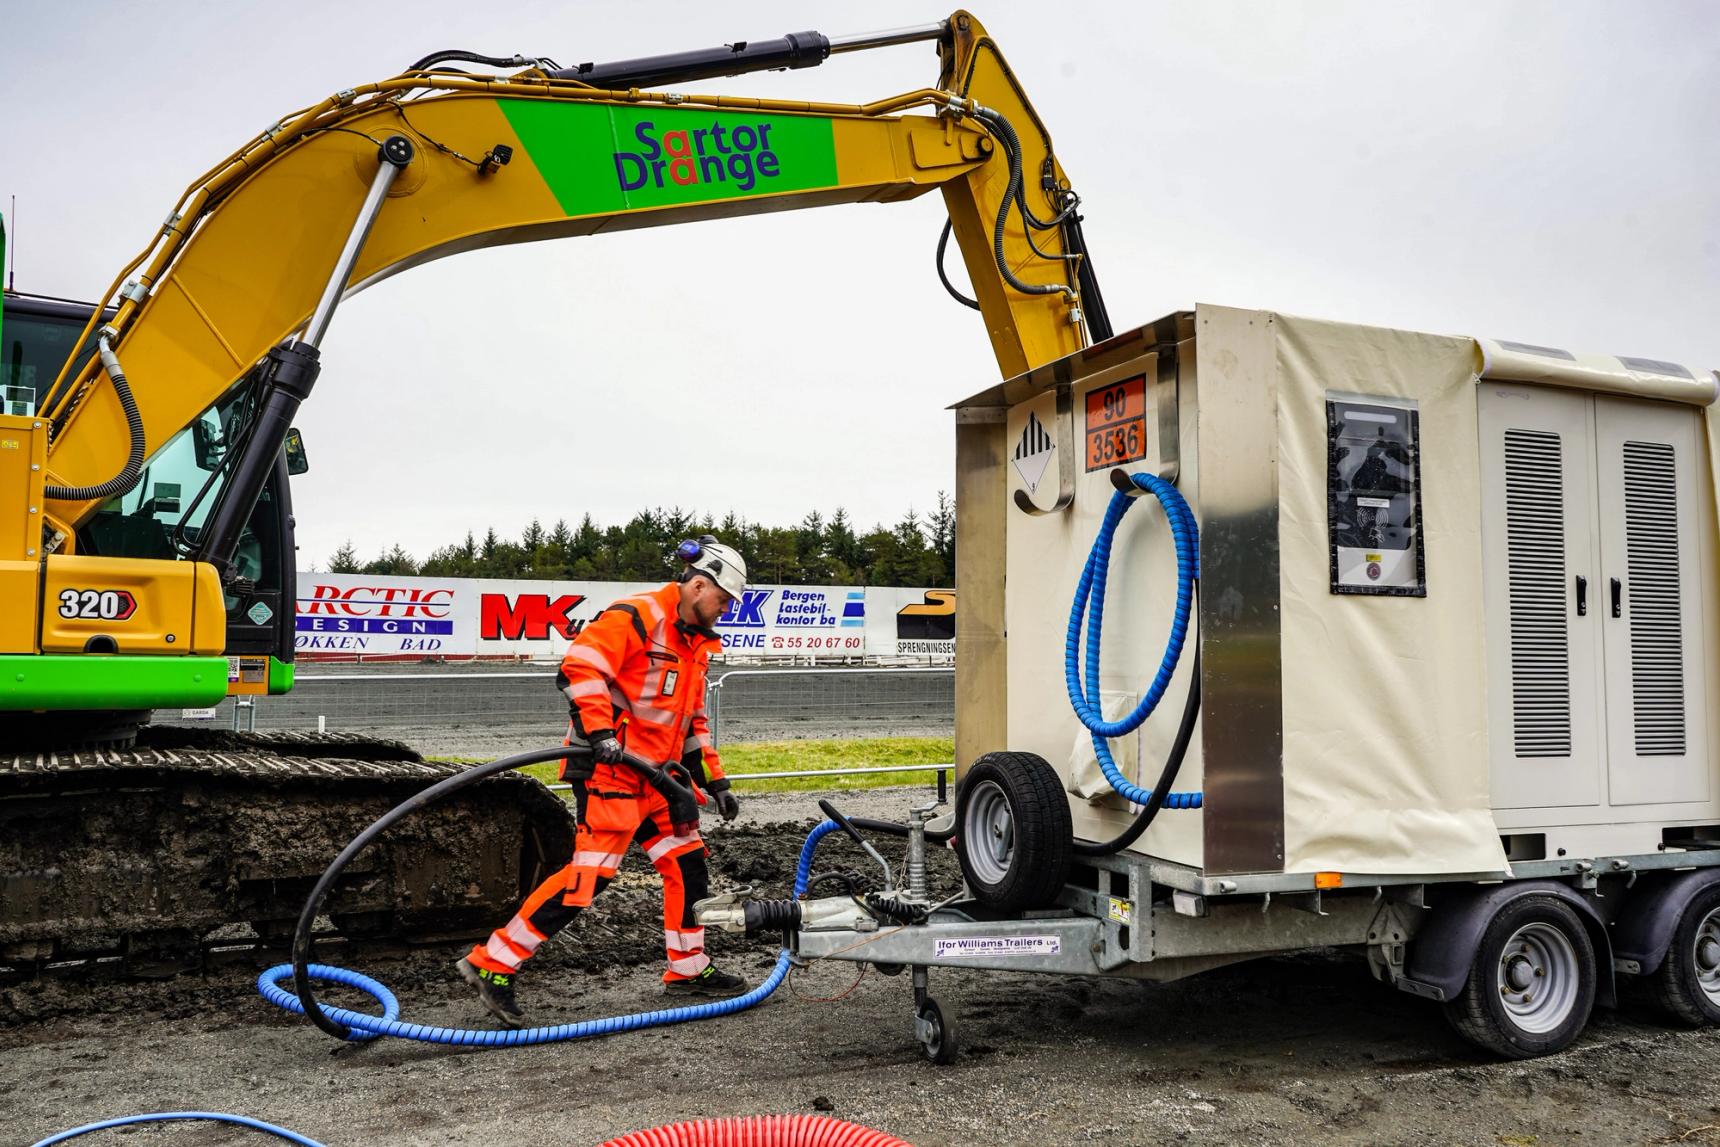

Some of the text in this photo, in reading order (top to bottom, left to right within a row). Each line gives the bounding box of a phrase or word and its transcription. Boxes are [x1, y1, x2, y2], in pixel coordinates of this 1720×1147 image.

[635, 121, 772, 161] Sartor
[613, 150, 780, 191] Drange
[1103, 387, 1126, 421] 90
[1093, 424, 1139, 464] 3536
[782, 590, 825, 602] Bergen
[60, 590, 119, 618] 320
[779, 602, 831, 614] Lastebil-
[296, 618, 426, 633] ESIGN
[776, 614, 836, 625] kontor ba
[400, 638, 442, 650] BAD
[787, 638, 860, 648] 55 20 67 60
[938, 941, 956, 949] Ifor
[958, 939, 1003, 948] Williams
[1004, 938, 1043, 947] Trailers
